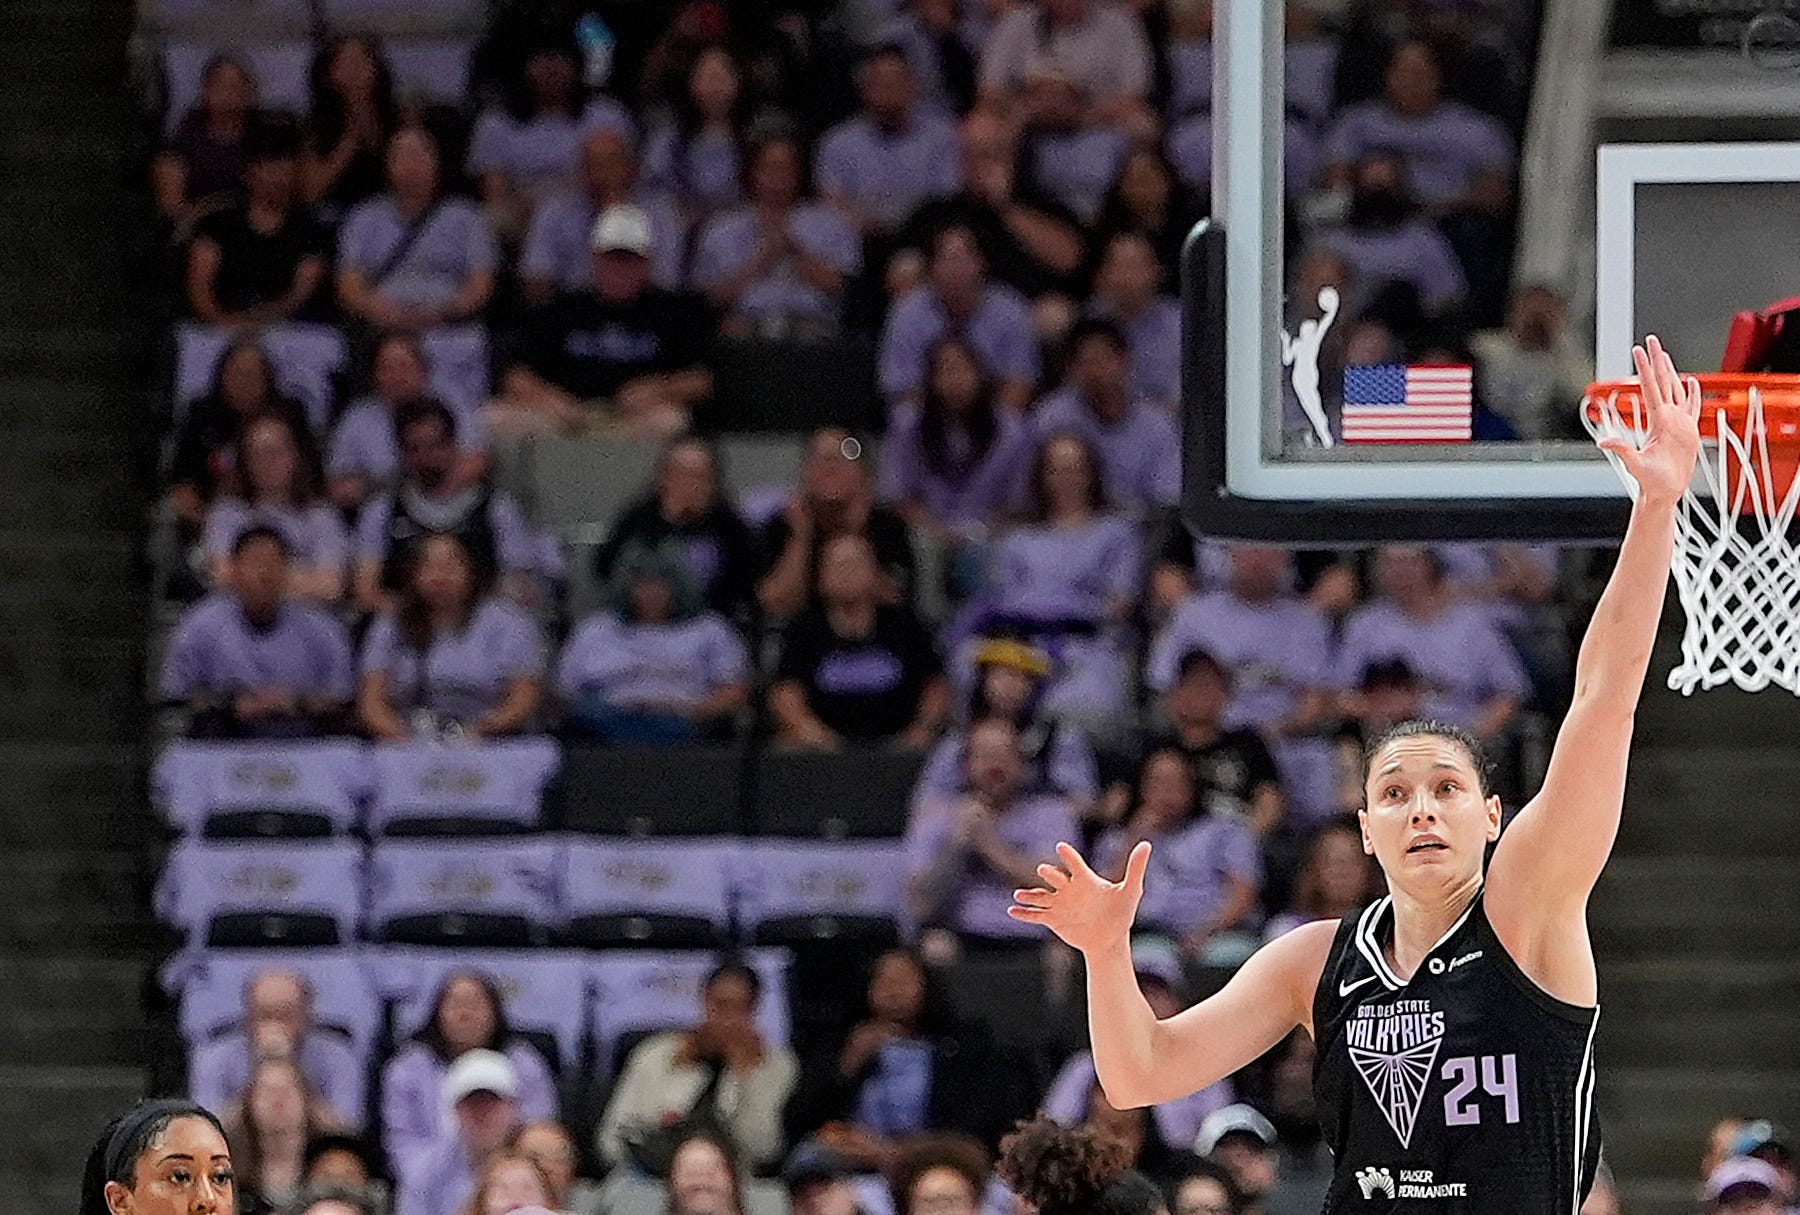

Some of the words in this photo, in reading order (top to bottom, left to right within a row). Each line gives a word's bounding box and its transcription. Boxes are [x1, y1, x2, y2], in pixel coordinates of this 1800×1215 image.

[1357, 1002, 1395, 1018] GOLDEN
[1396, 1000, 1430, 1013] STATE
[1346, 1011, 1445, 1053] VALKYRIES
[1441, 1054, 1520, 1126] 24
[1400, 1170, 1433, 1183] KAISER
[1398, 1183, 1467, 1198] PERMANENTE
